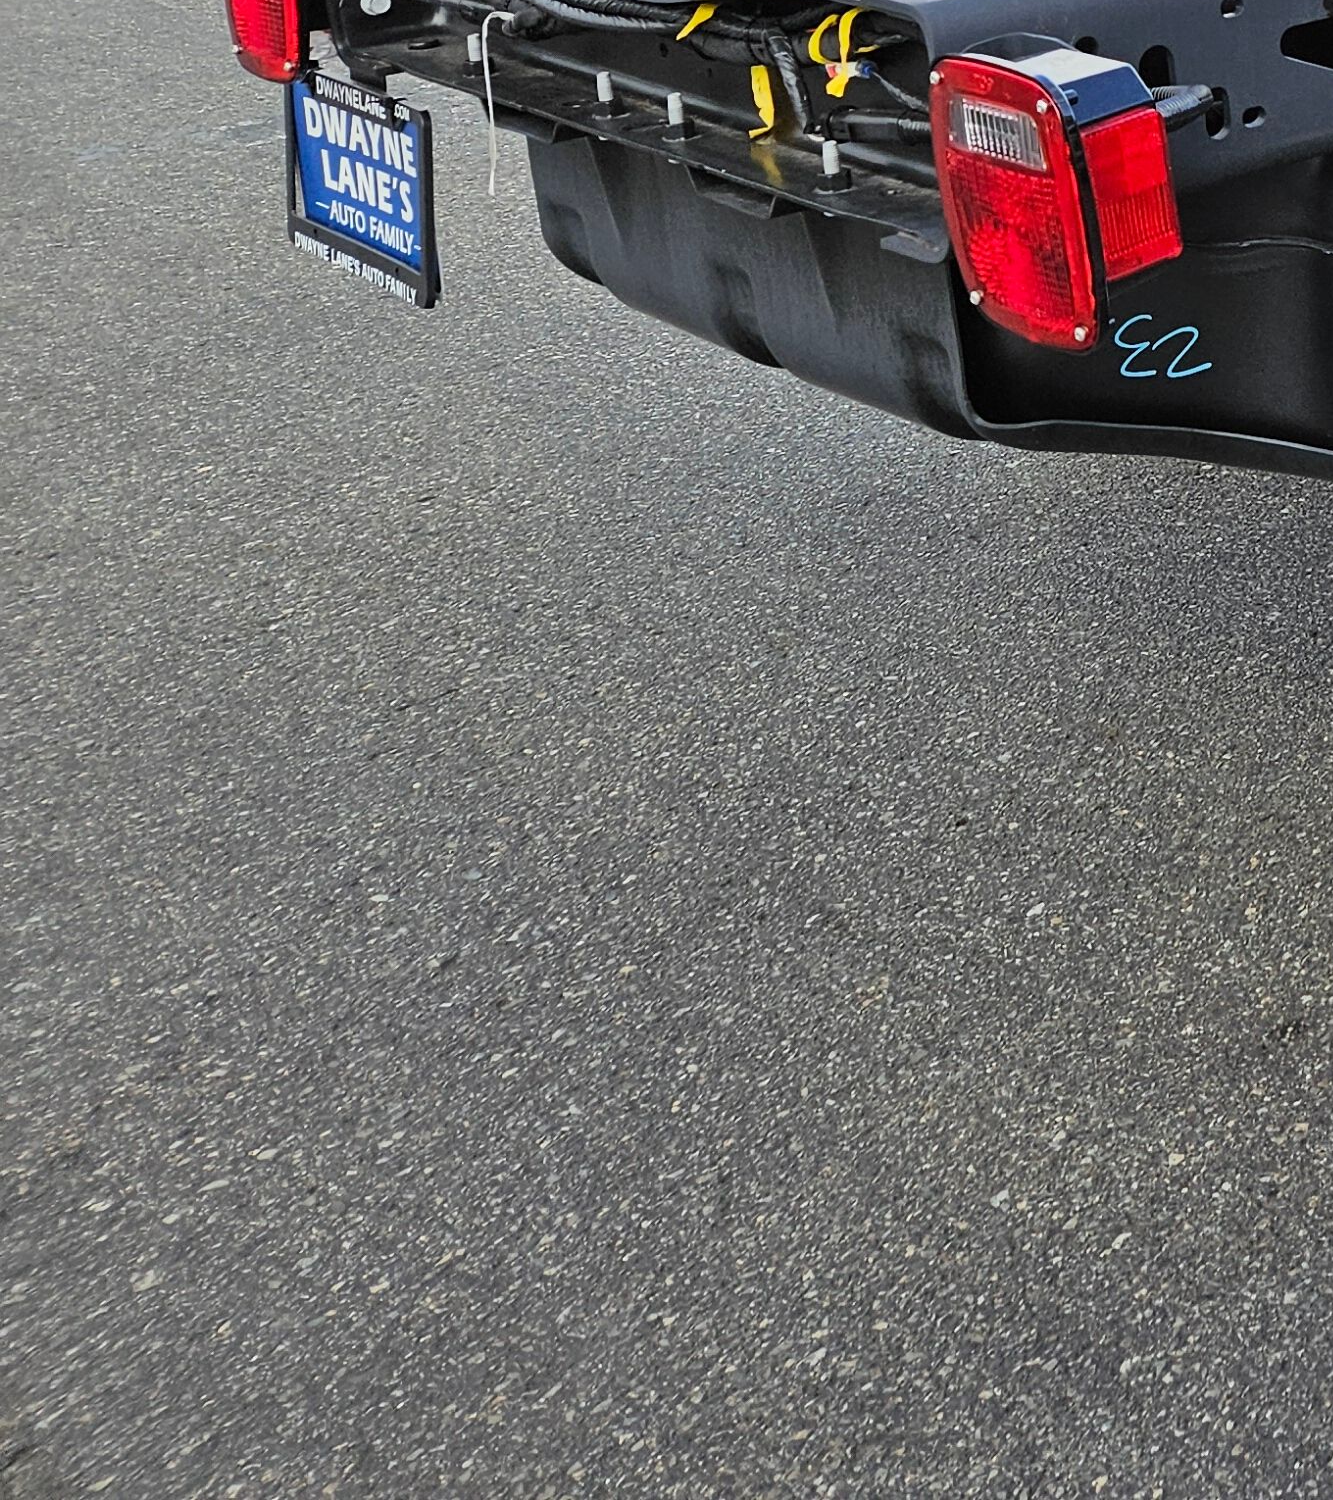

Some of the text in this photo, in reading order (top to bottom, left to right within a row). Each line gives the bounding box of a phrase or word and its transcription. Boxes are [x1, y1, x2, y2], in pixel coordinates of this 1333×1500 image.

[303, 96, 417, 178] DWAYNE
[321, 148, 414, 223] LANE'S
[329, 200, 415, 256] AUTO FAMILY
[294, 231, 417, 305] DWAYNE LANE'S AUTO FAMILY
